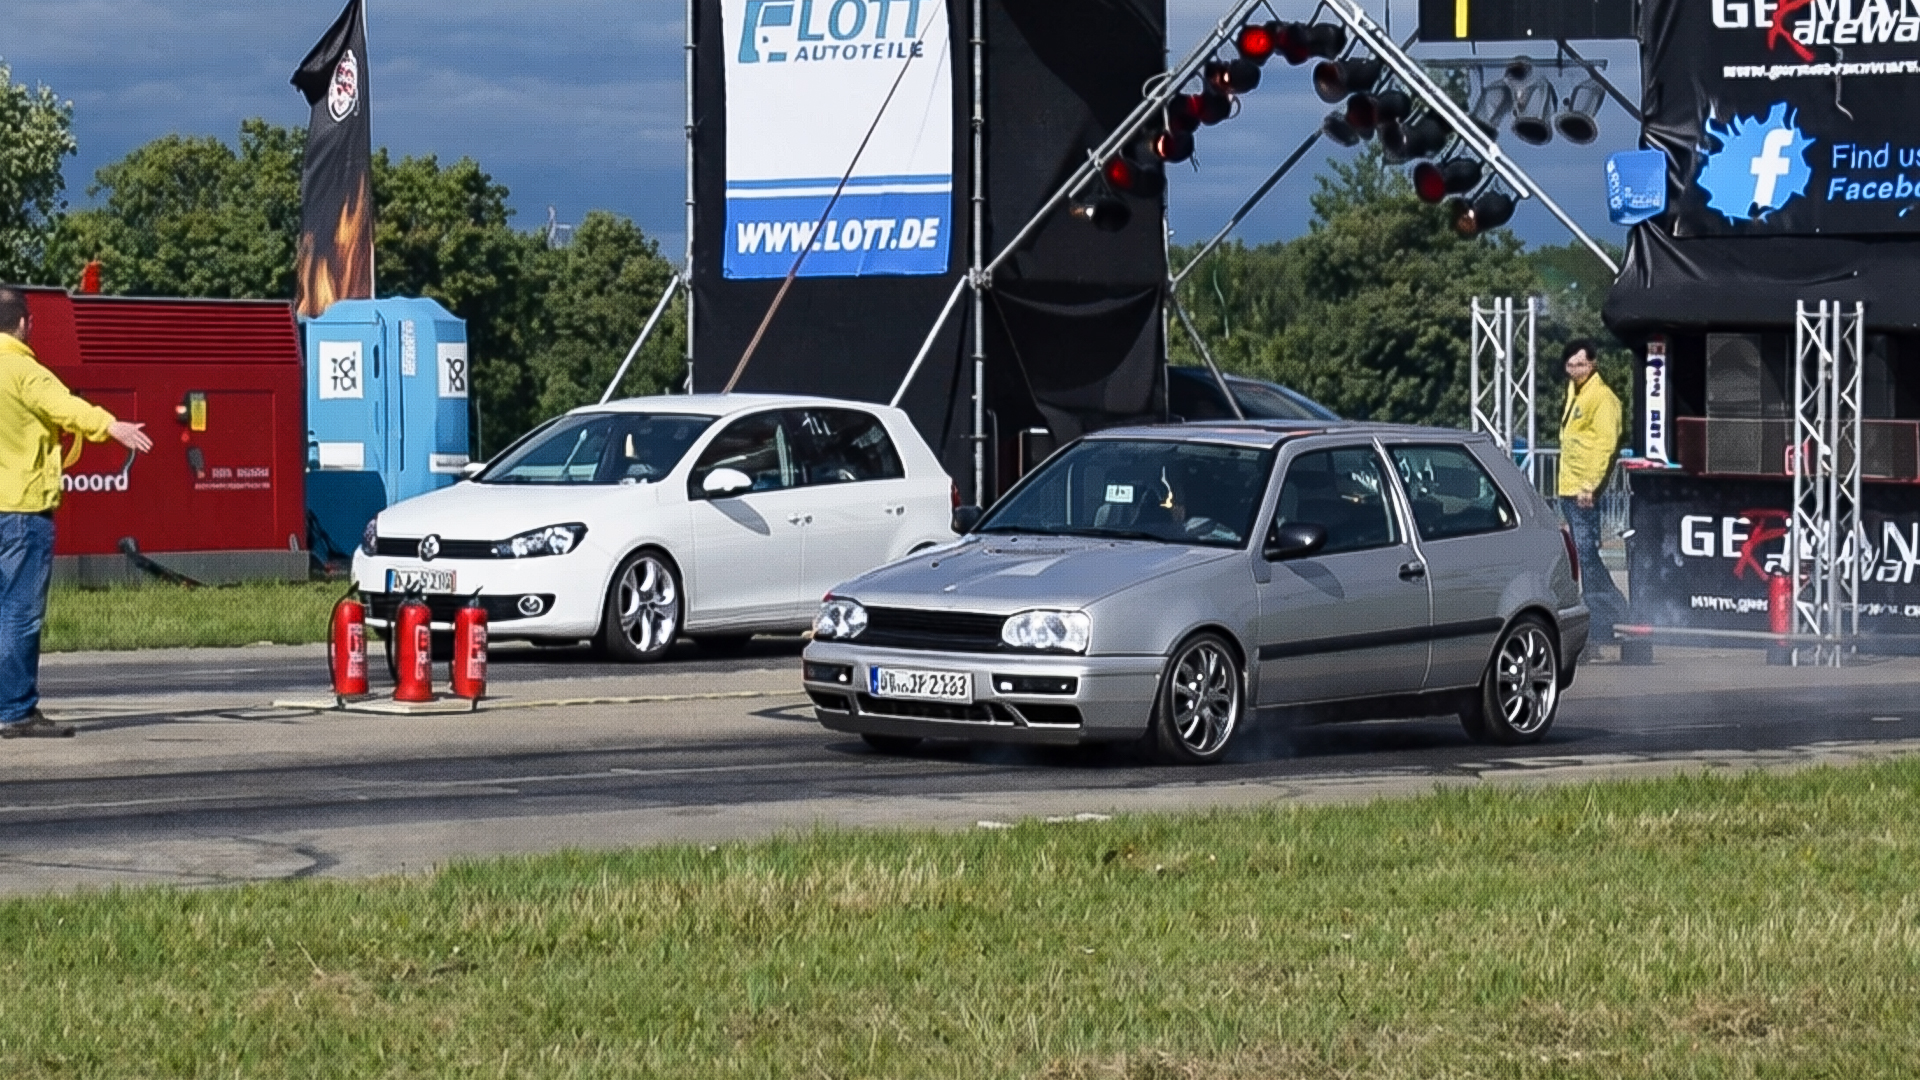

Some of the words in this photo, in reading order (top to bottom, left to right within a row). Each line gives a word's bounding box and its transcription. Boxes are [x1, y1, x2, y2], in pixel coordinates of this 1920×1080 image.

[794, 41, 924, 62] AUTOTEILE
[1833, 142, 1889, 169] Find
[737, 217, 940, 254] WWW.LOTT.DE
